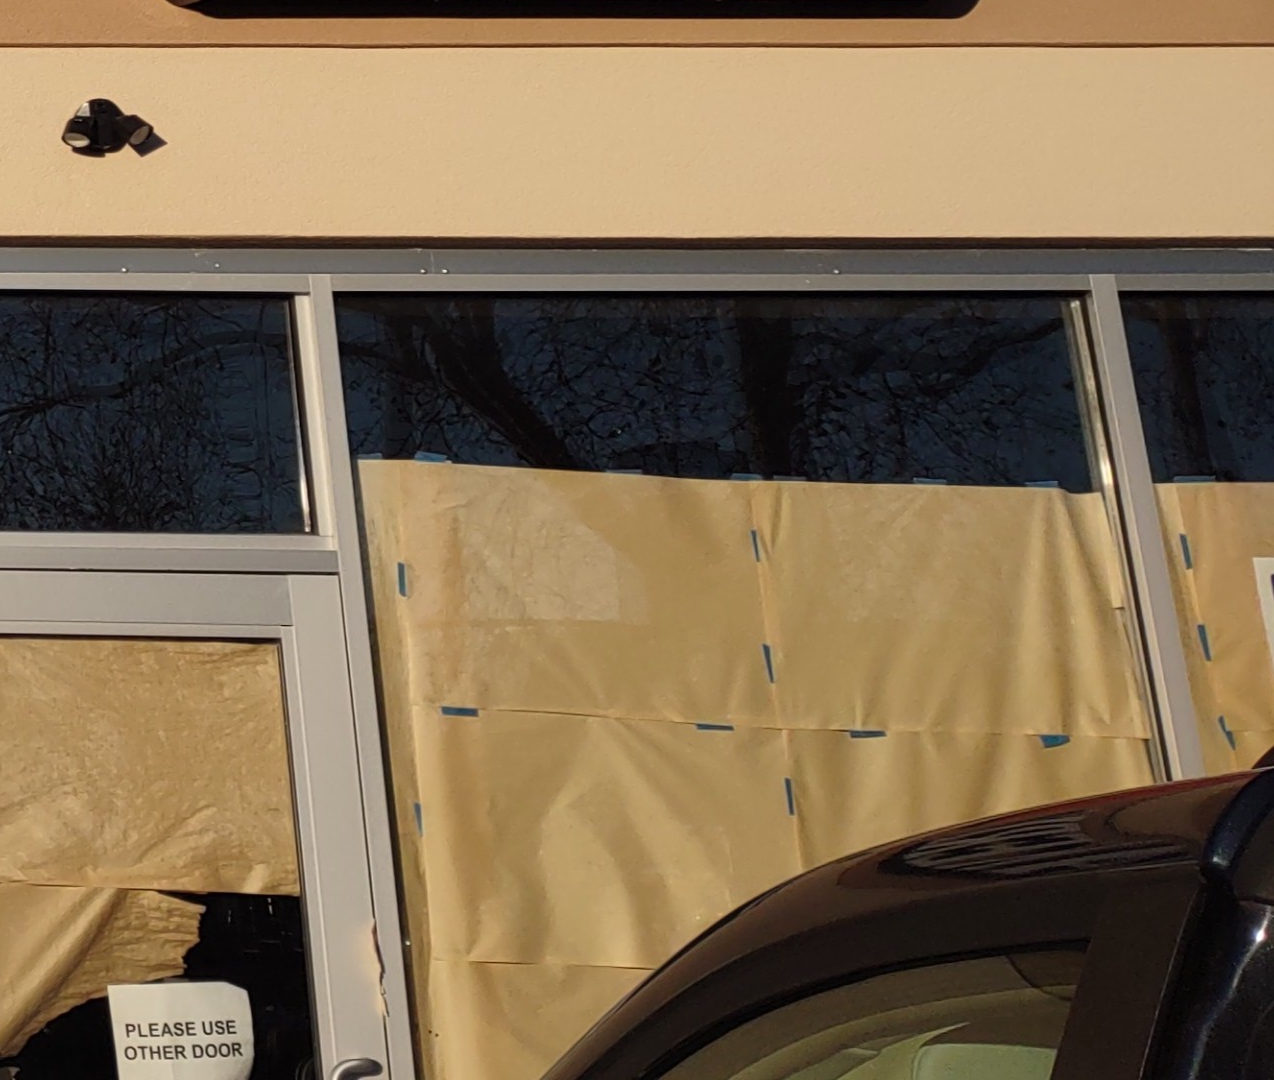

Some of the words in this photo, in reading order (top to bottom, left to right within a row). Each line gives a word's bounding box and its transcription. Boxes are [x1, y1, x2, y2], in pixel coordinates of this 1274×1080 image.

[125, 1021, 197, 1038] PLEASE
[202, 1020, 237, 1036] USE
[124, 1044, 187, 1061] OTHER
[192, 1042, 244, 1059] DOOR
